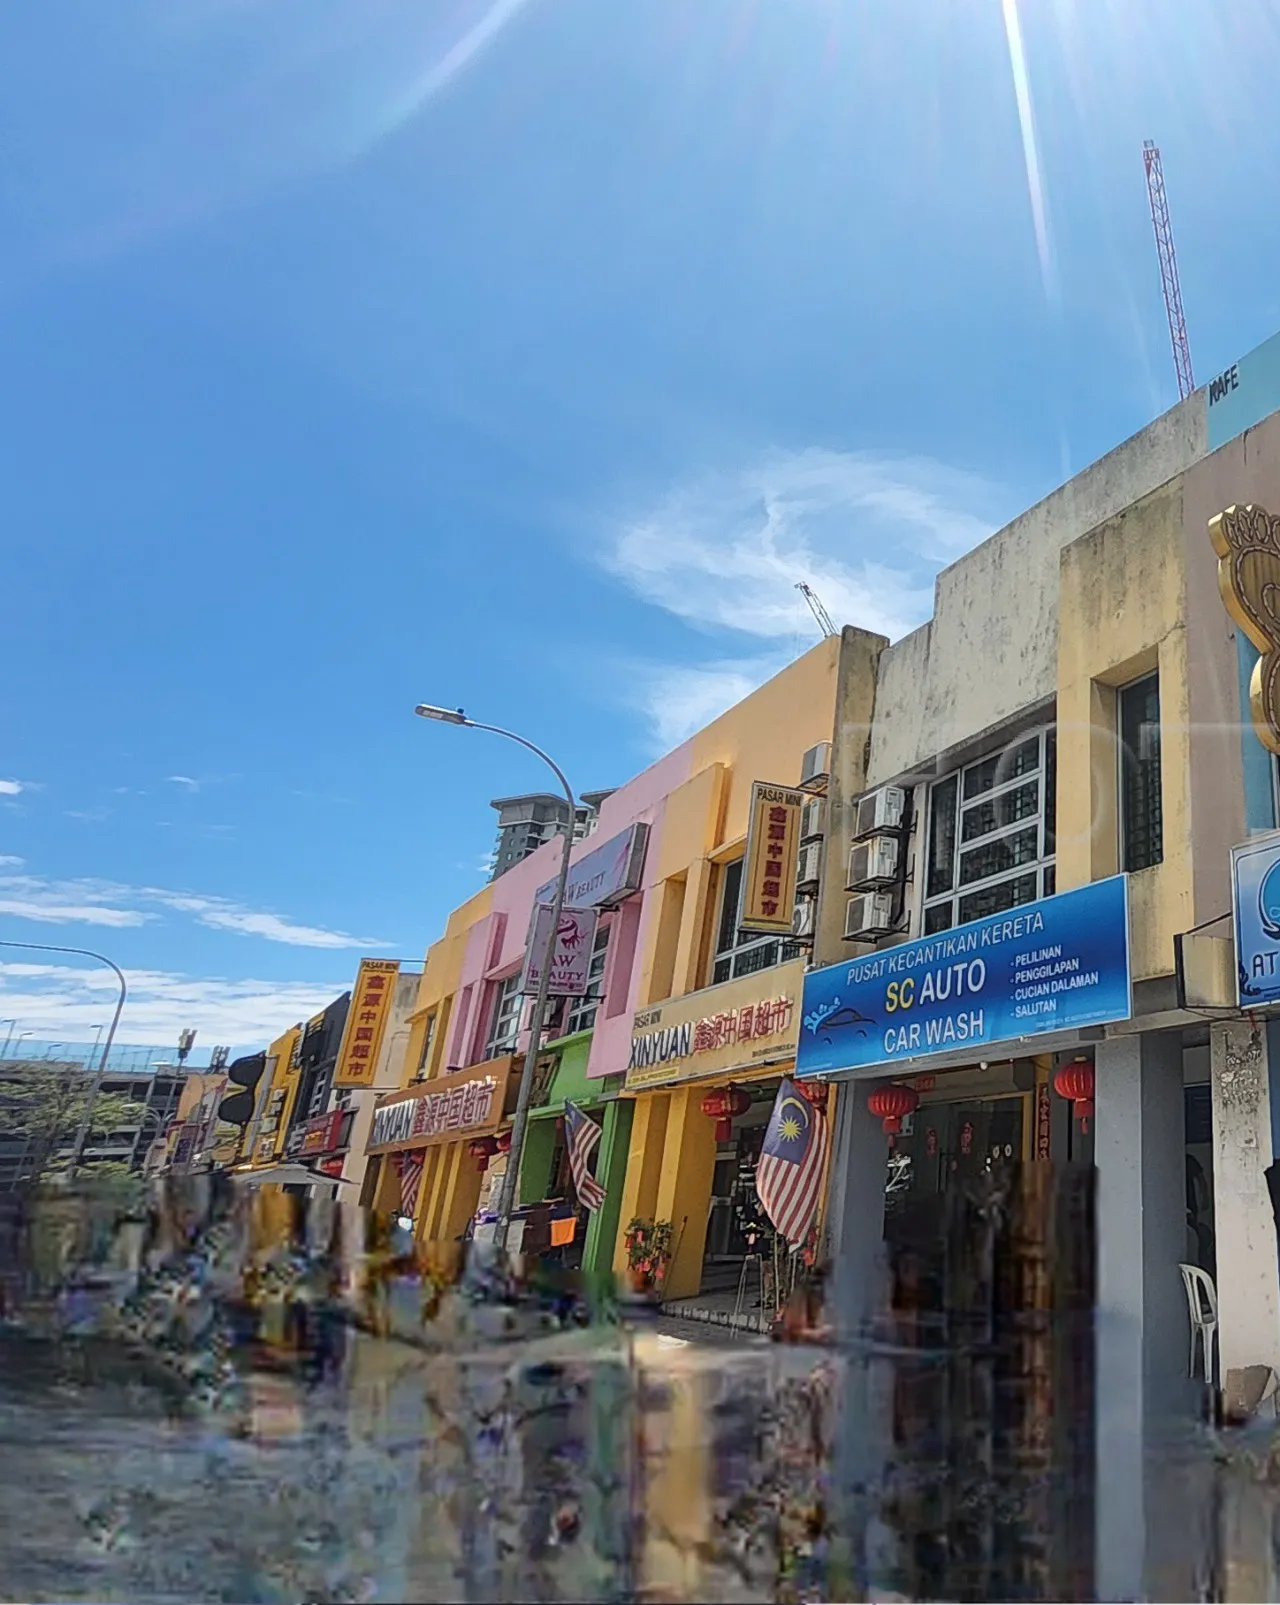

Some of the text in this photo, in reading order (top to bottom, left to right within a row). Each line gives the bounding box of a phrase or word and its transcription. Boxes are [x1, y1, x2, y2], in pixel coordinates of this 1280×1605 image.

[757, 788, 784, 803] PASAR
[847, 911, 1044, 986] PUSAT KECANTIKAN KERETA
[1015, 944, 1062, 968] PELILINAN
[530, 968, 585, 980] BAUTY
[1015, 957, 1080, 985] PENGGILAPAN
[1252, 950, 1280, 979] AT
[884, 957, 987, 1014] SC AUTO
[1015, 971, 1099, 1002] CUCIAN DALAMAN
[1015, 999, 1057, 1019] SALUTAN
[629, 1020, 693, 1071] XINYUAN
[884, 1008, 985, 1055] CAR WASH
